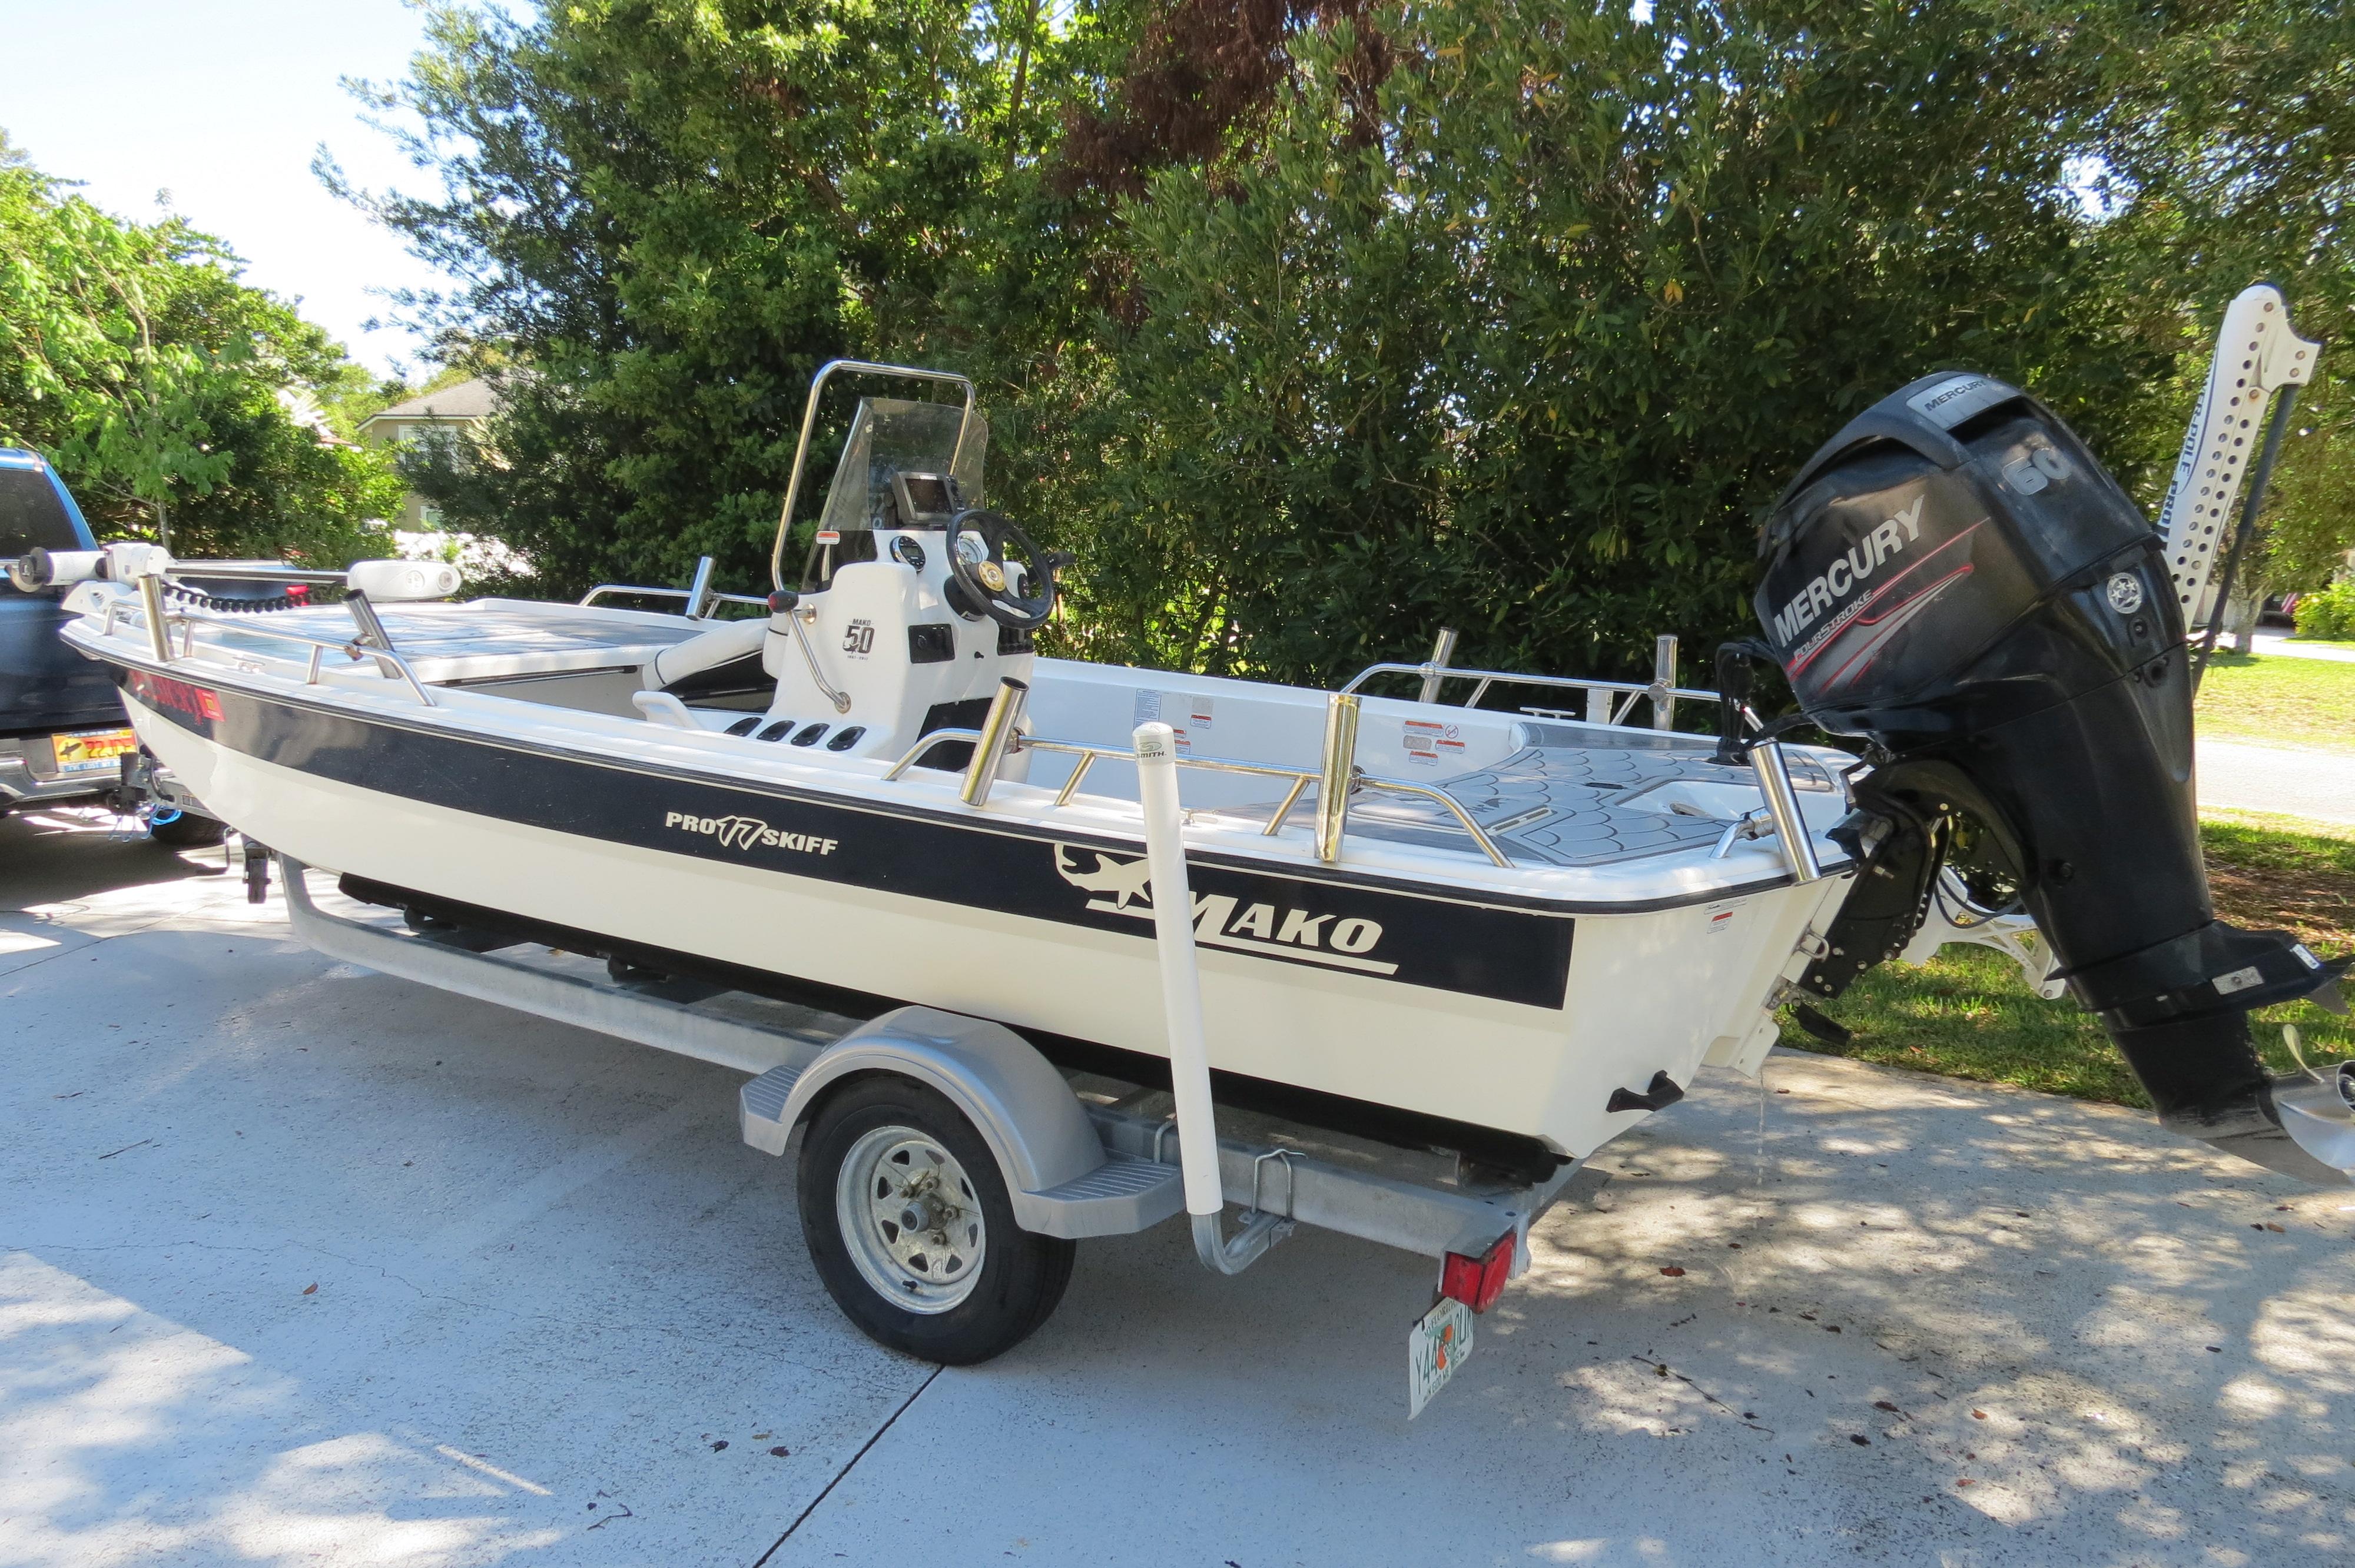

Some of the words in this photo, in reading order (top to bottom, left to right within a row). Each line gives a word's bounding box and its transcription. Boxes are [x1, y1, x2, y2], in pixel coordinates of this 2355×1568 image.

[1924, 380, 1986, 411] MERCURY
[2002, 448, 2072, 495] 60
[2161, 480, 2179, 524] PRO
[1773, 494, 1925, 647] MERCURY
[843, 625, 875, 654] 50
[1793, 590, 1873, 662] FOURSTROKE
[665, 811, 716, 835] PRO
[761, 829, 839, 856] SKIFF
[1189, 891, 1383, 954] MAKO
